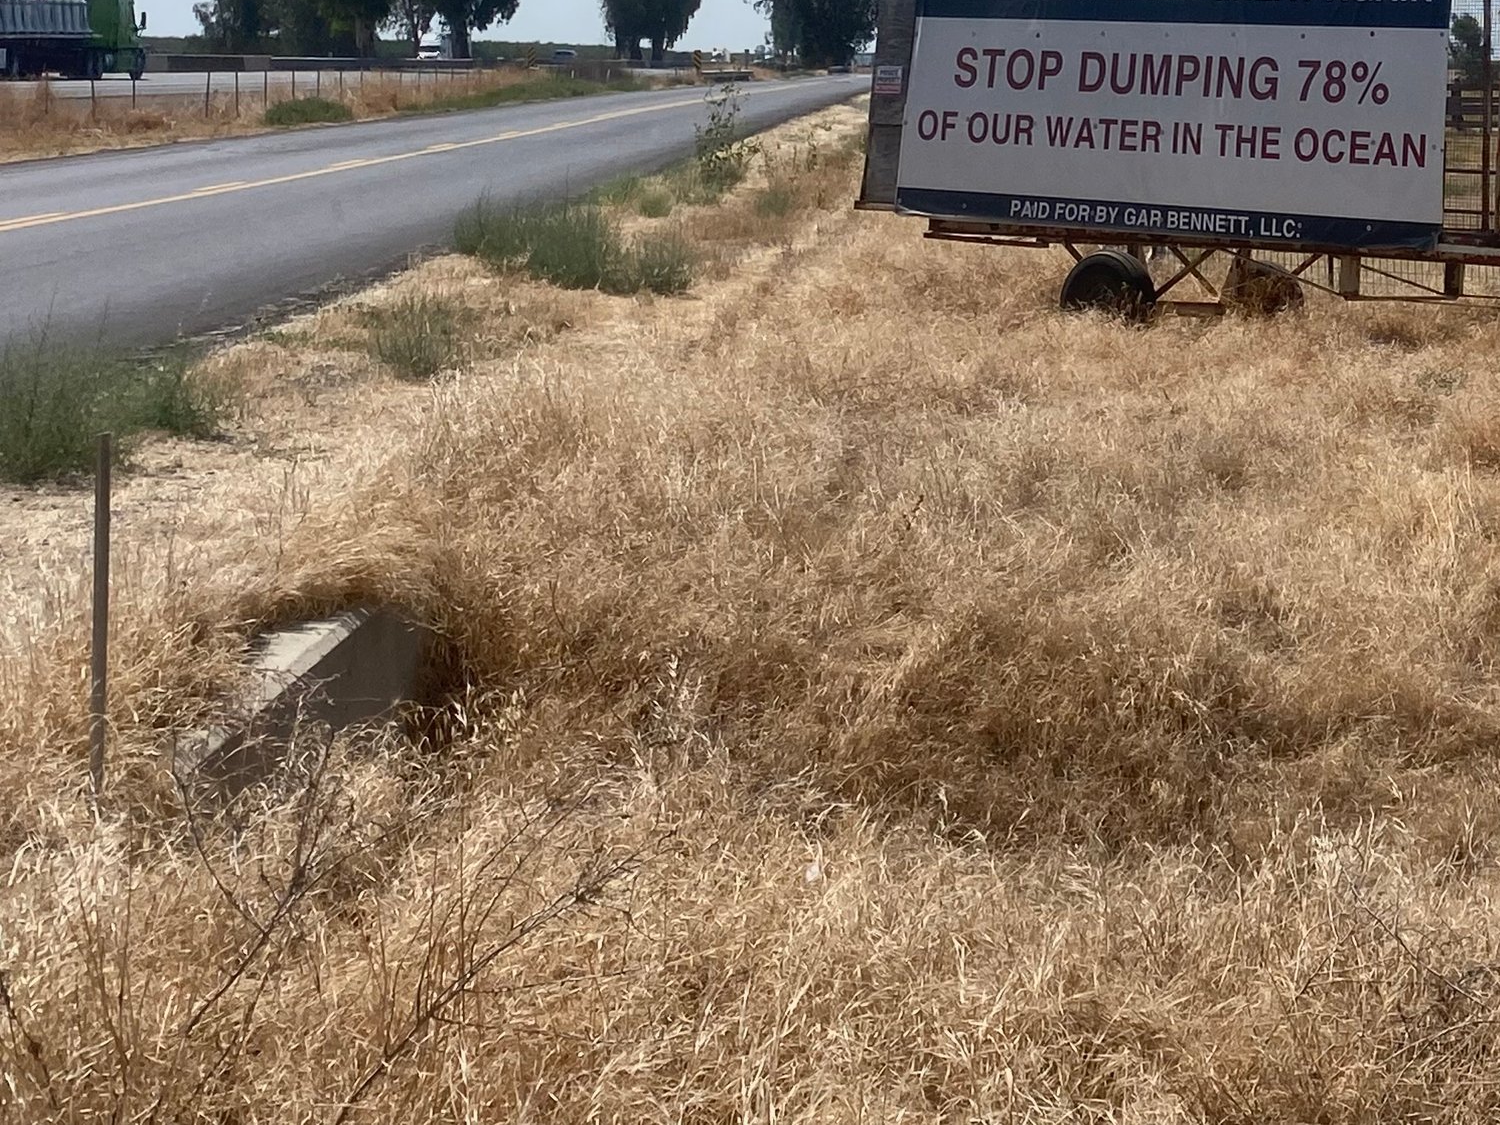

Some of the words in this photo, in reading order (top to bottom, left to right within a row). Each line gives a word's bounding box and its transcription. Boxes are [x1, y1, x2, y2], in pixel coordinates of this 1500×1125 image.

[954, 47, 1063, 91] STOP
[1078, 51, 1279, 101] DUMPING
[1298, 59, 1389, 105] 78%
[918, 110, 958, 141] OF
[967, 112, 1034, 146] OUR
[1046, 116, 1161, 153] WATER
[1172, 122, 1202, 155] IN
[1214, 124, 1281, 160] THE
[1294, 127, 1426, 168] OCEAN
[1010, 199, 1049, 219] PAID
[1054, 204, 1090, 222] FOR
[1096, 206, 1119, 223] BY
[1124, 208, 1161, 227] GAR
[1167, 211, 1254, 237] BENNETT,
